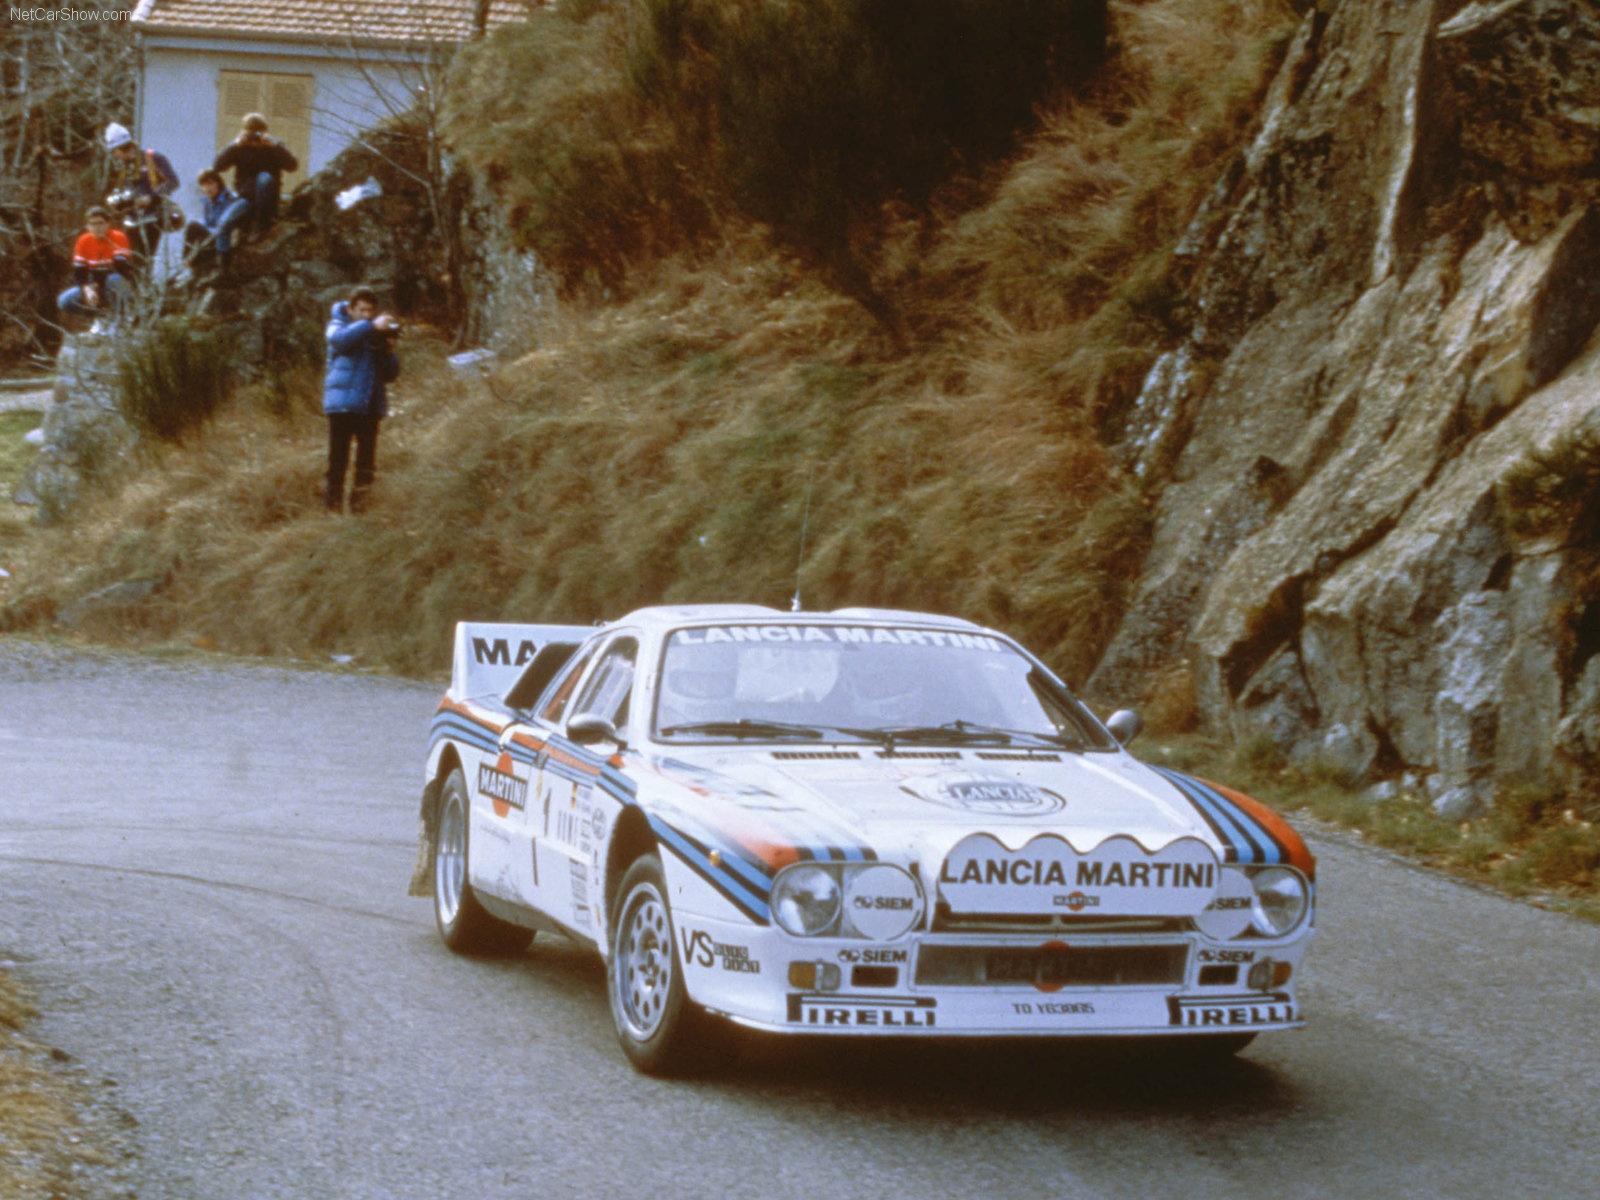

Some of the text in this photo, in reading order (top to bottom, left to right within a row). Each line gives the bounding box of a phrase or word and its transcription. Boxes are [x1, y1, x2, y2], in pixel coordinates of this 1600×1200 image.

[678, 626, 1001, 651] LANCIA MARTINI
[940, 857, 1215, 889] LANCIA MARTINI
[874, 896, 914, 910] SIEM
[681, 927, 715, 969] VS
[862, 949, 907, 963] SIEM
[787, 992, 937, 1026] PIRELLI
[1166, 992, 1293, 1026] PIRELLI
